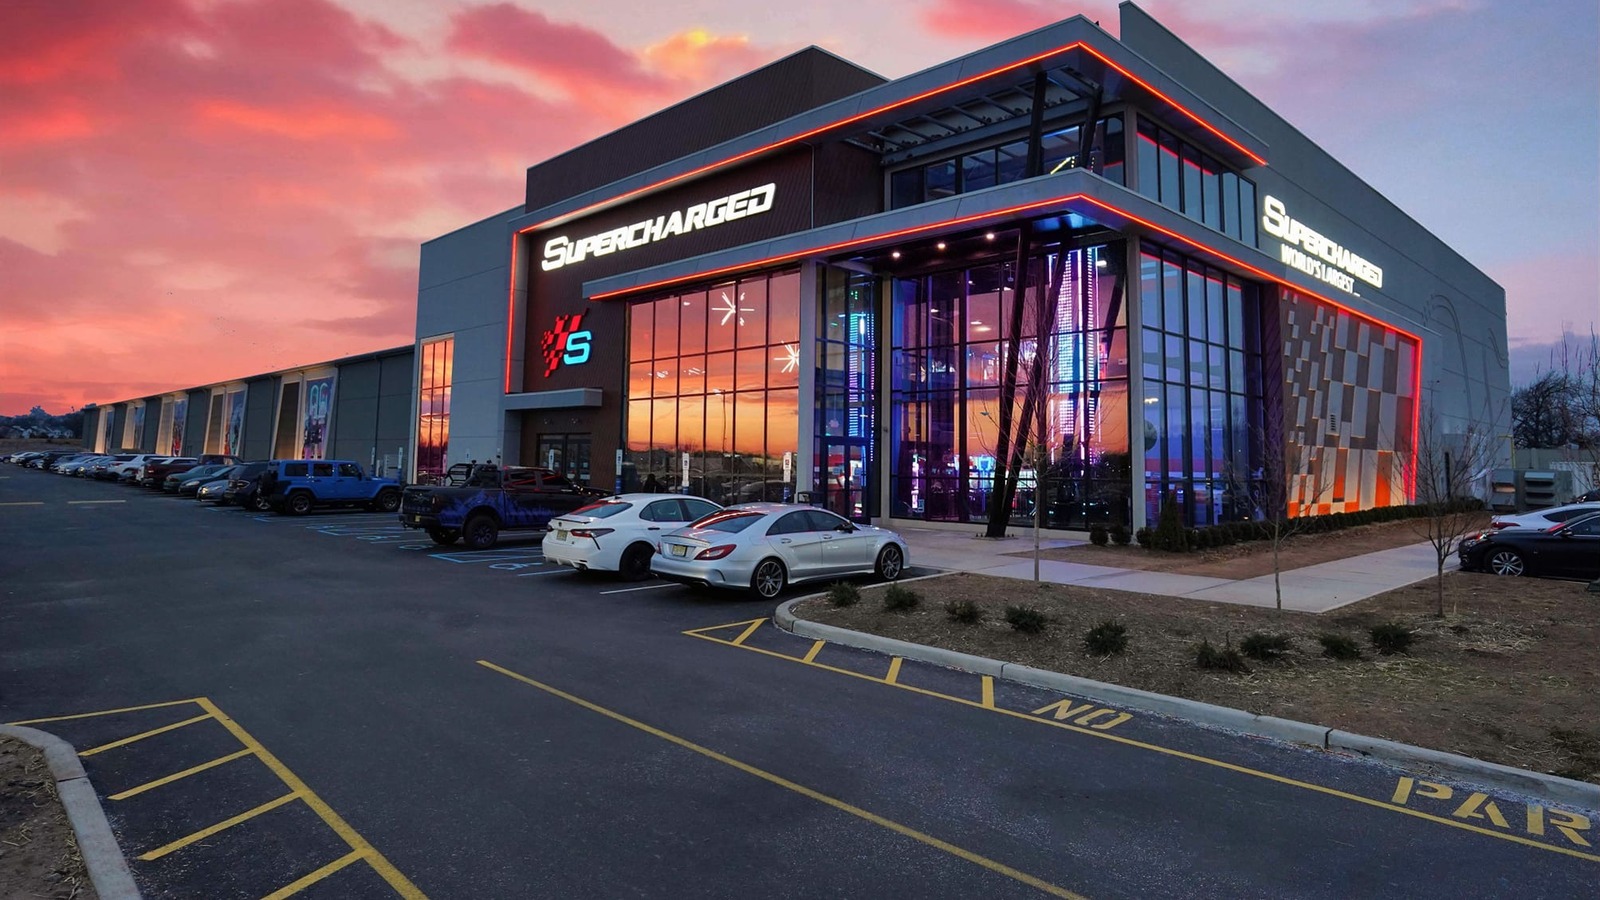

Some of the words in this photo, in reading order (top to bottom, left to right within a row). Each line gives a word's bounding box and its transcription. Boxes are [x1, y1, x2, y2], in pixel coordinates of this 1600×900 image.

[541, 183, 776, 271] SUPERCHARGED
[1263, 194, 1383, 288] SUPERCHARGED
[1281, 243, 1321, 279] WORLD'S
[1321, 264, 1355, 294] LARGEST
[1031, 699, 1134, 729] NO
[1391, 776, 1592, 847] PAR
